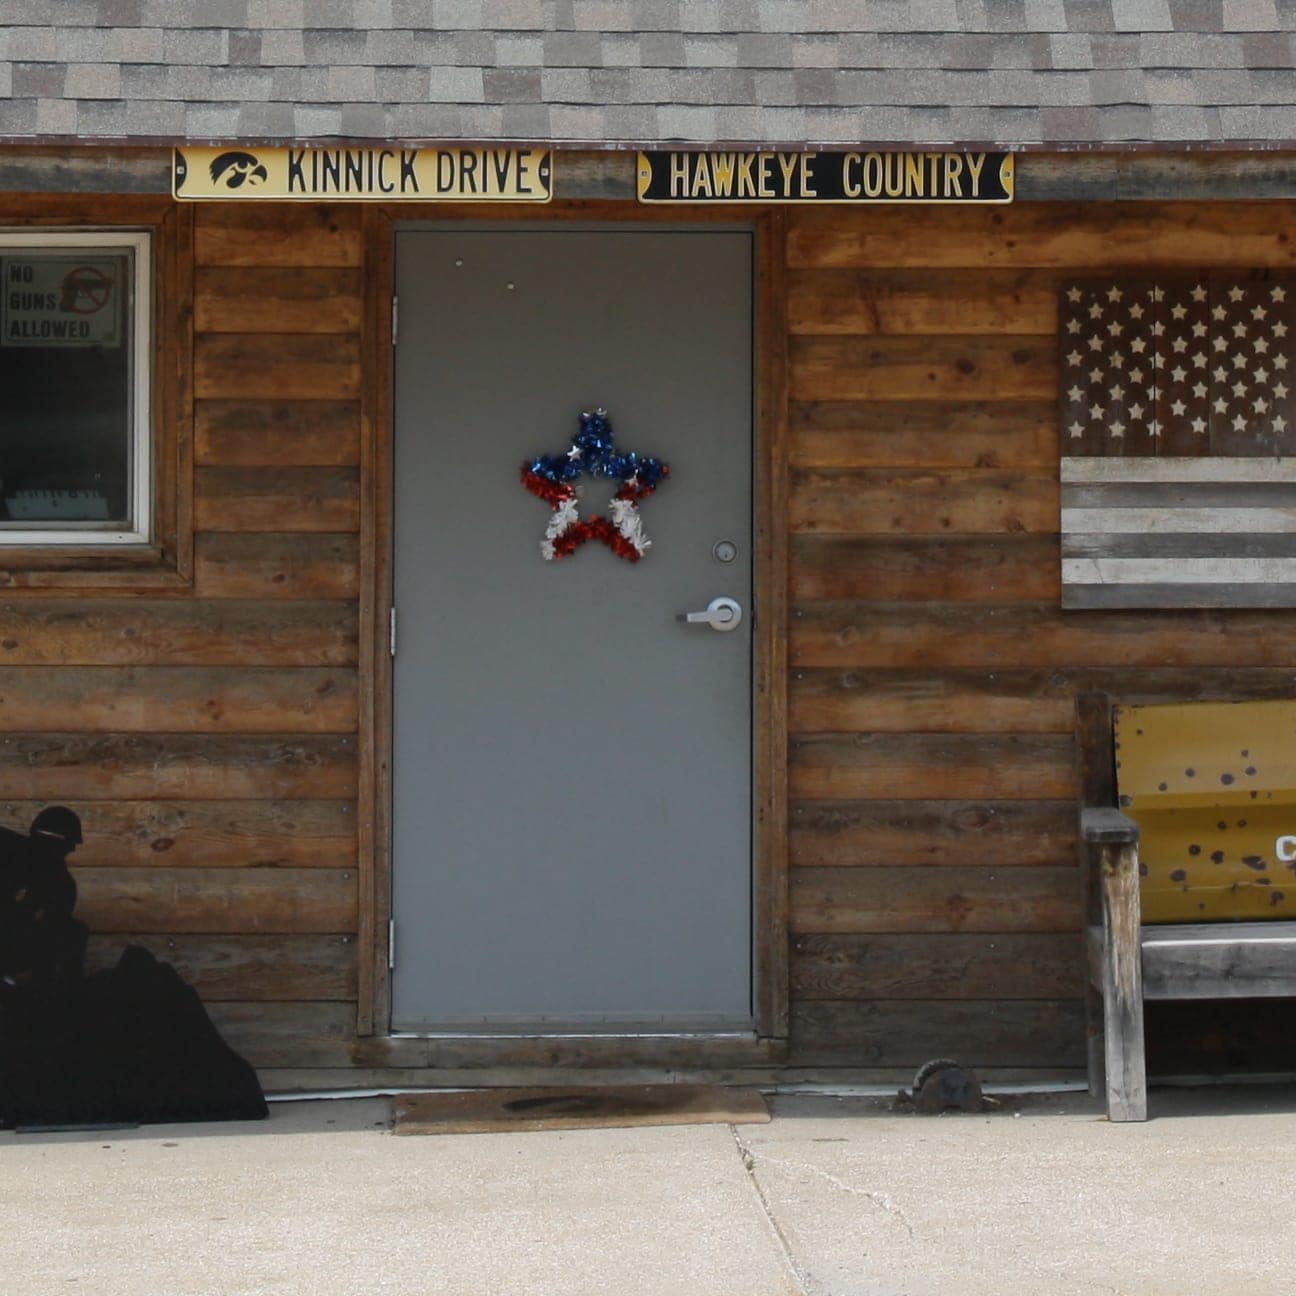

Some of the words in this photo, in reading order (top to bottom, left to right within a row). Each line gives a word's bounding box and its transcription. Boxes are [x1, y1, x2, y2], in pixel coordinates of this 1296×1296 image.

[287, 150, 420, 193] KINNICK
[436, 150, 533, 194] DRIVE
[669, 153, 818, 198] HAWKEYE
[842, 153, 987, 198] COUNTRY
[9, 264, 34, 283] NO
[9, 292, 57, 312] GUNS
[9, 319, 91, 339] ALLOWED
